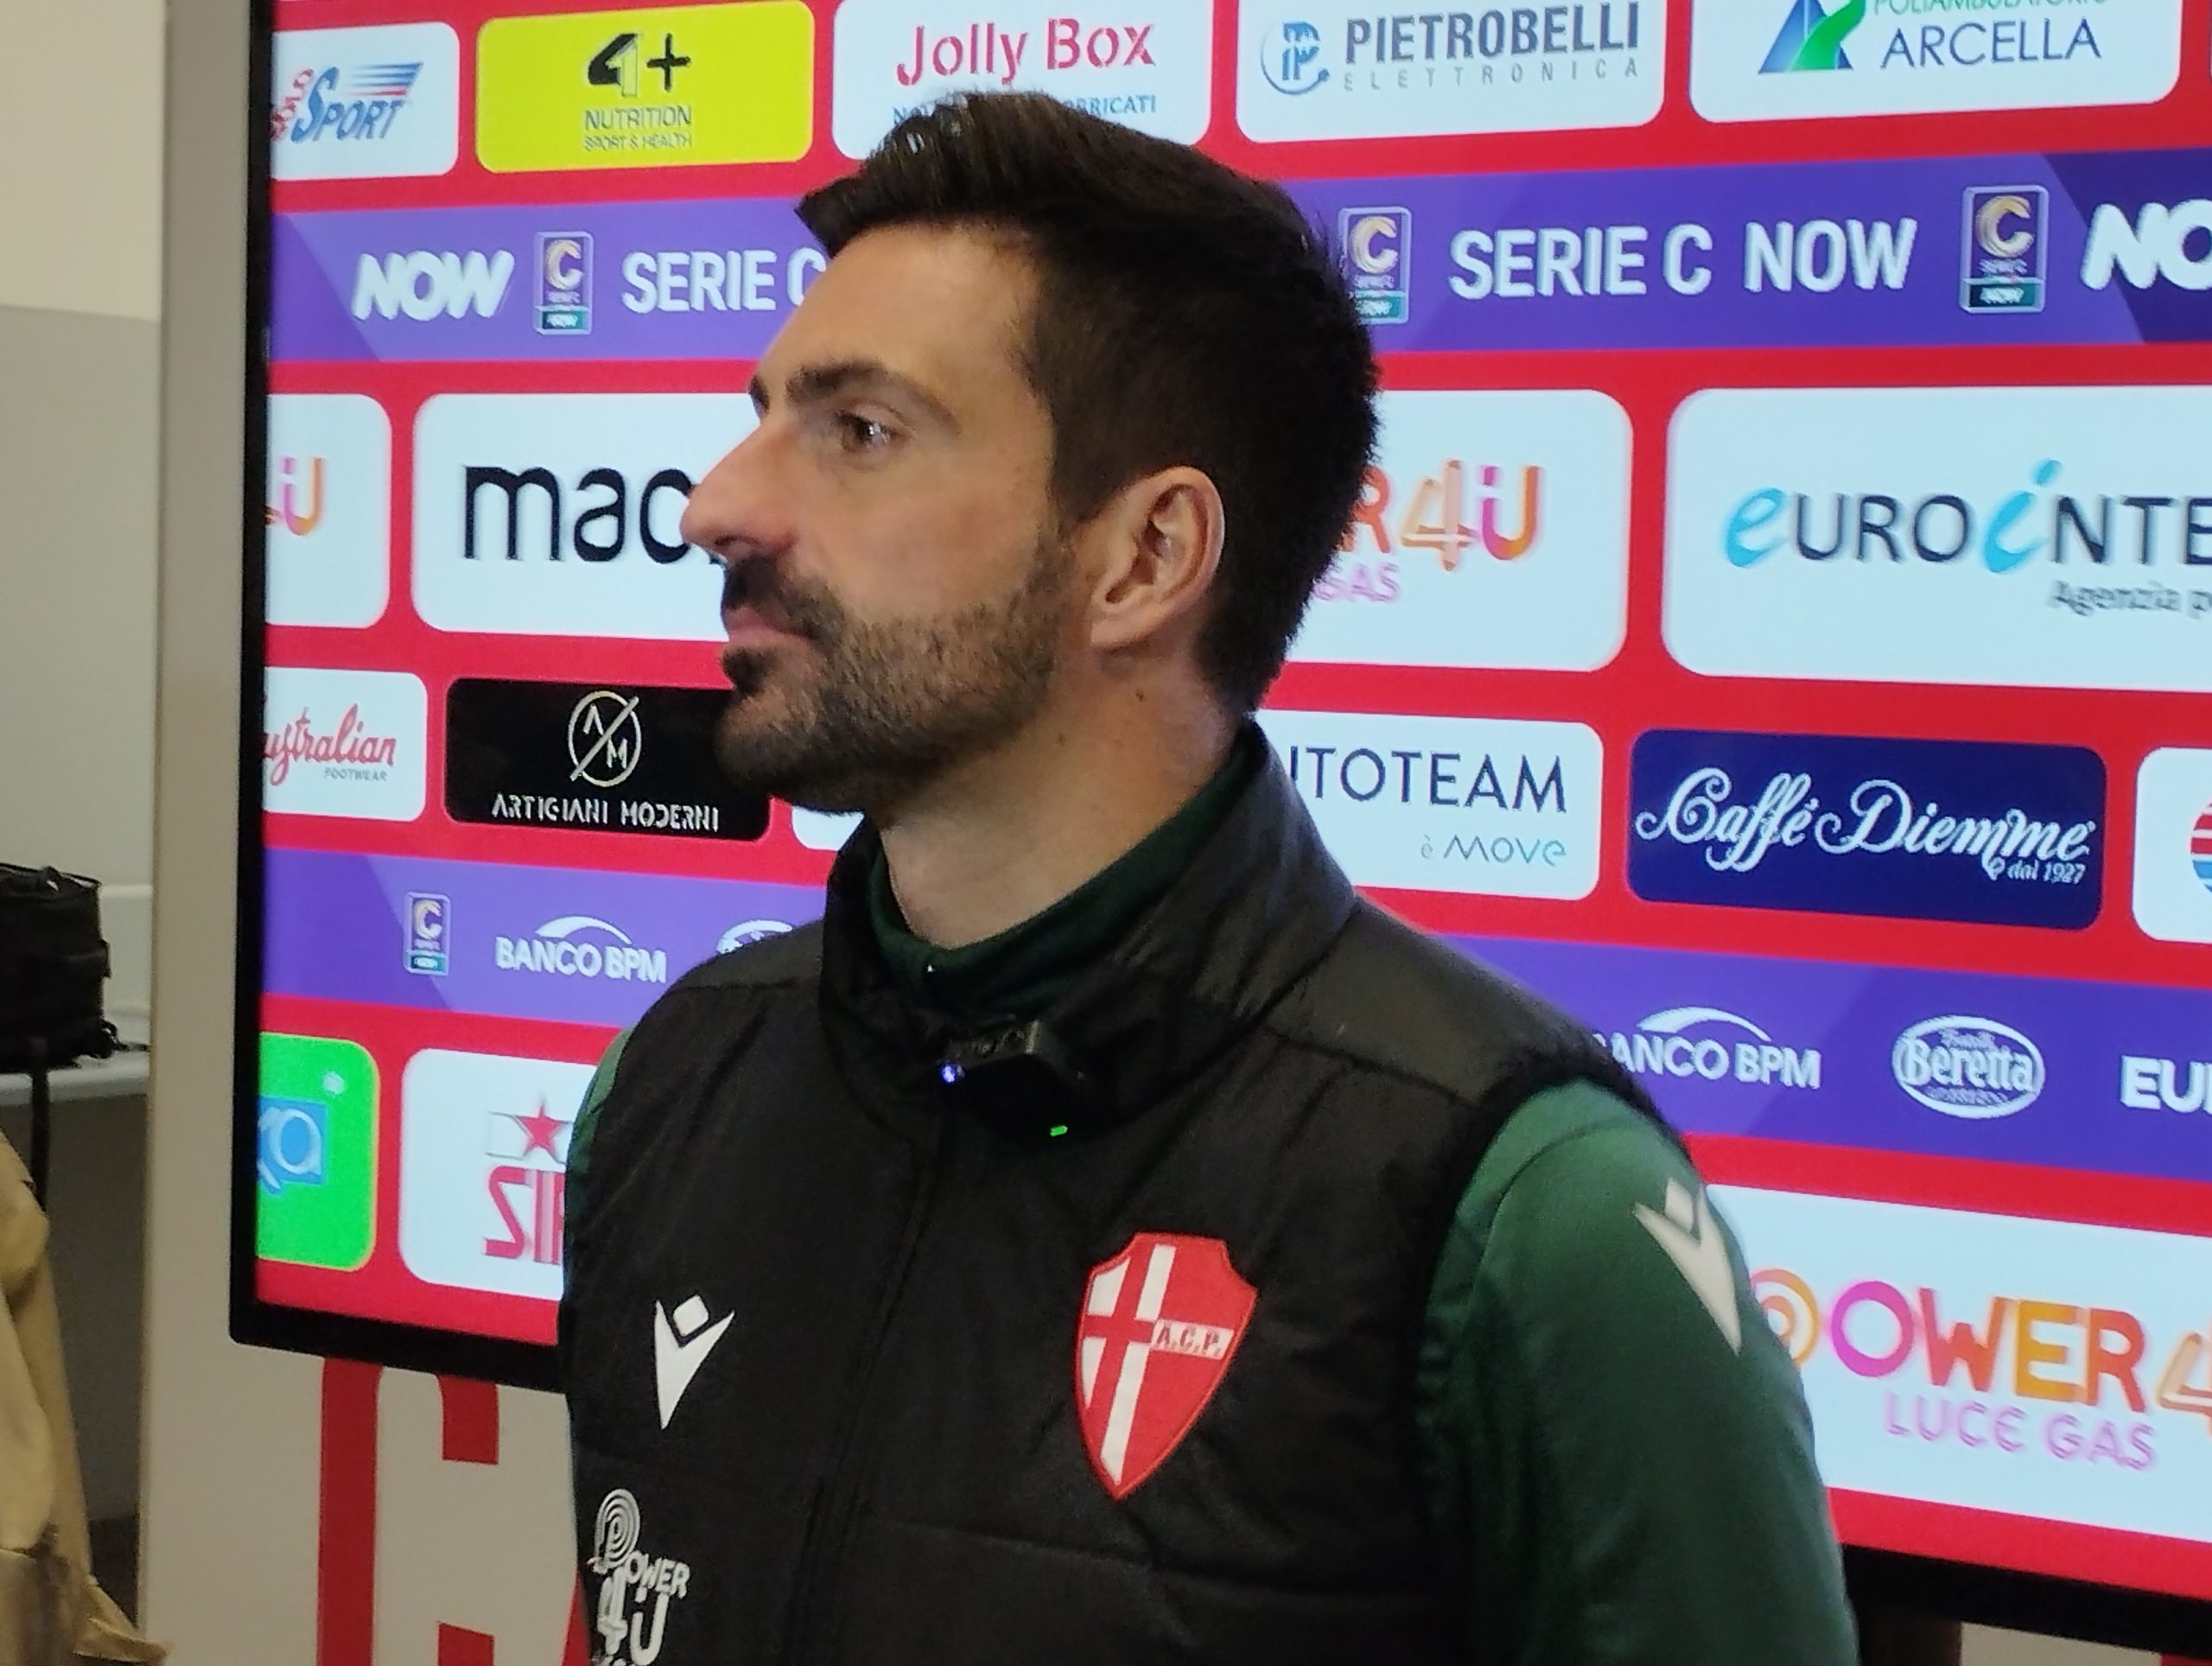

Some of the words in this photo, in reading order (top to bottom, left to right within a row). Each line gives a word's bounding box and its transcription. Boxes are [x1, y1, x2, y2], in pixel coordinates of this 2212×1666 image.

[895, 22, 1027, 86] Jolly
[1046, 19, 1155, 69] Box
[1344, 3, 1638, 64] PIETROBELLI
[1880, 17, 2101, 69] ARCELLA
[290, 66, 408, 143] SPORT
[1344, 56, 1638, 92] ELETTRONICA
[584, 105, 692, 130] NUTRITION
[1446, 226, 1648, 299] SERIE
[1663, 224, 1713, 295] C
[1744, 218, 1917, 292] NOW
[2080, 199, 2212, 290] NO
[352, 251, 515, 321] NOW
[622, 250, 777, 314] SERIE
[463, 467, 691, 564] mac
[261, 703, 397, 786] ustralian
[324, 767, 388, 781] FOOTWEAR
[1290, 746, 1567, 813] TOTEAM
[491, 792, 608, 824] ARTIGIANI
[620, 799, 720, 832] MODERNI
[1815, 779, 2090, 881] Diemme
[2043, 862, 2086, 885] 1927
[495, 937, 602, 977] BANCO
[603, 945, 666, 983] BPM
[1594, 1033, 1730, 1080] ANCO
[1734, 1042, 1822, 1091] BPM
[1901, 1037, 2034, 1092] Beretta
[1884, 1391, 2024, 1453] LUCE
[2044, 1412, 2156, 1470] GAS
